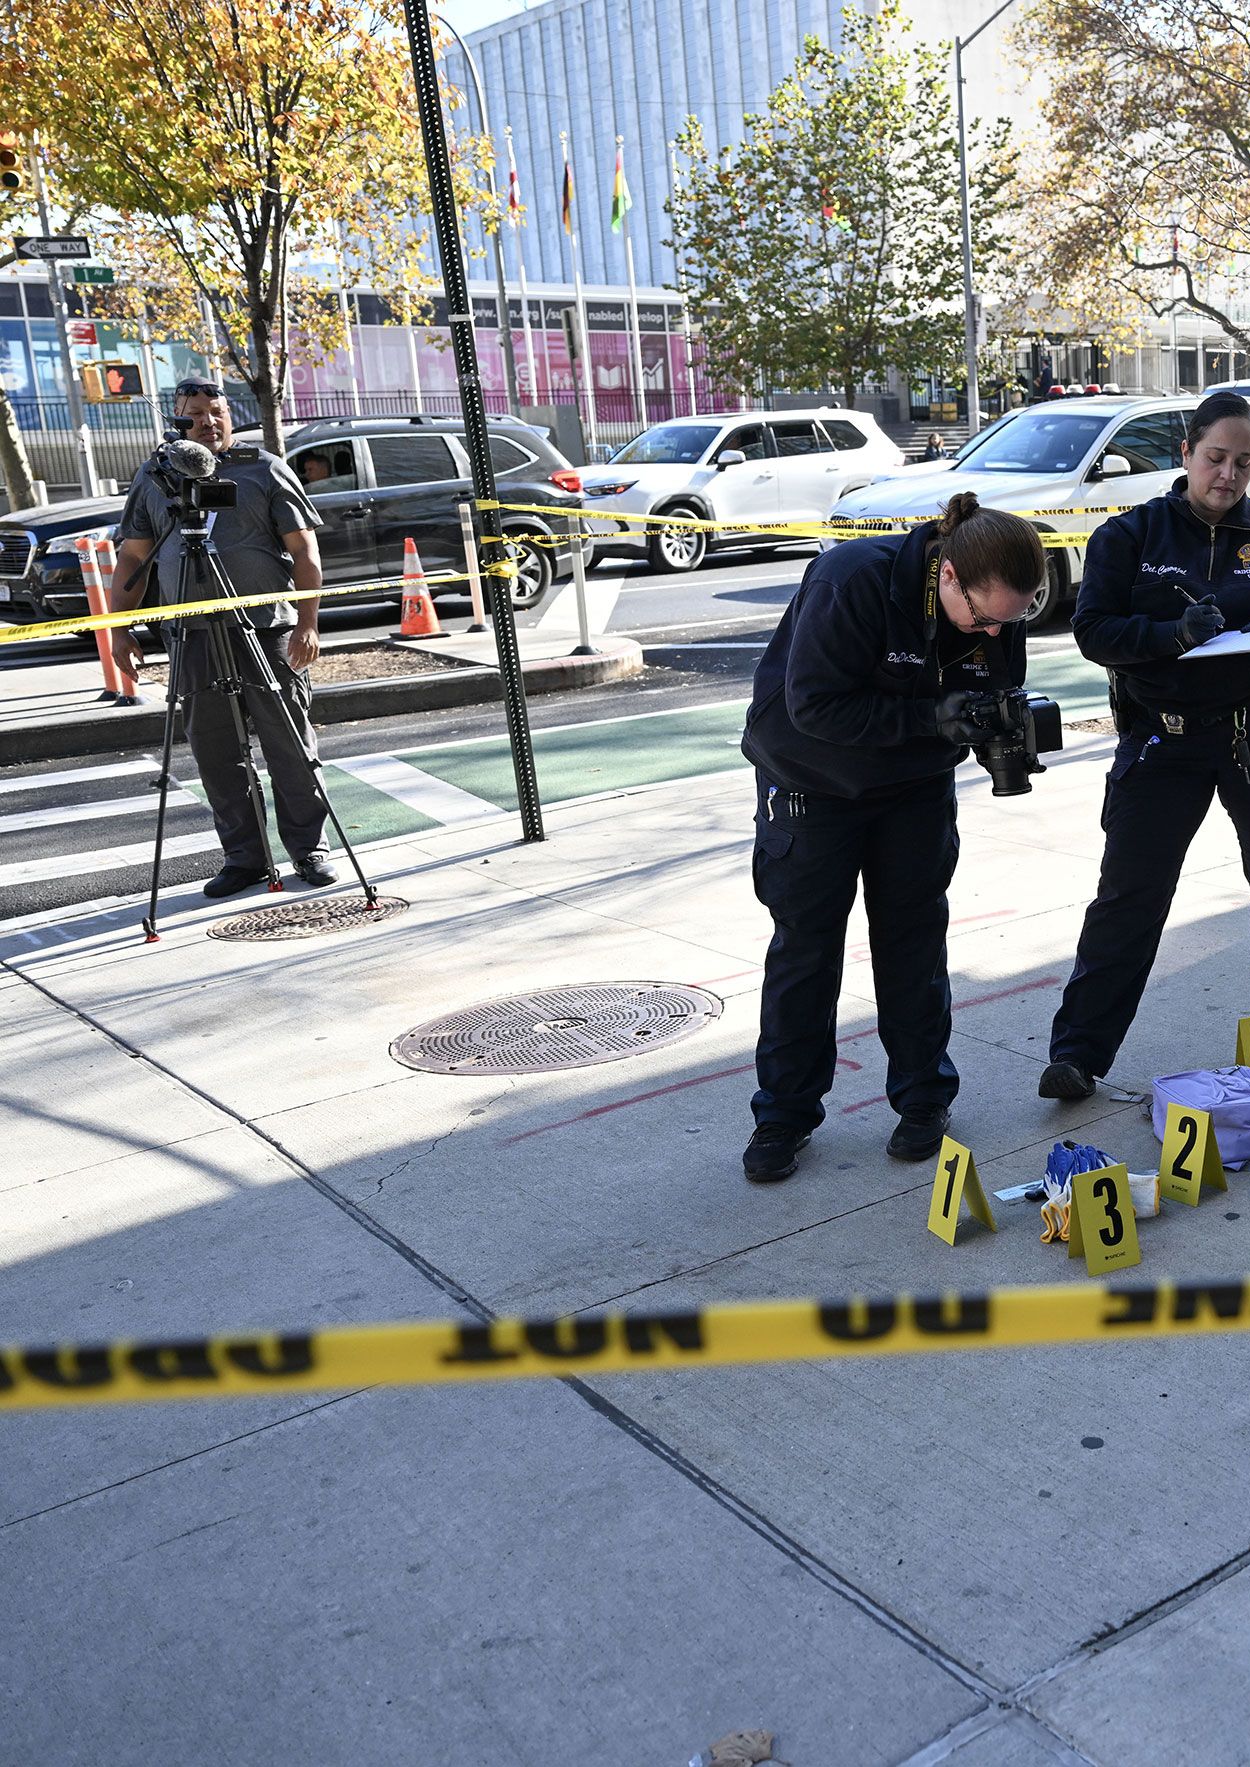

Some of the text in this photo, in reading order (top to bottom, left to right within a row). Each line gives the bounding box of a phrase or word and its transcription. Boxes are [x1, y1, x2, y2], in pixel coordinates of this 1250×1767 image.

[29, 243, 81, 253] ONE WAY
[83, 268, 89, 281] 1
[1171, 1115, 1198, 1181] 2
[943, 1153, 960, 1219] 1
[1093, 1177, 1125, 1247] 3
